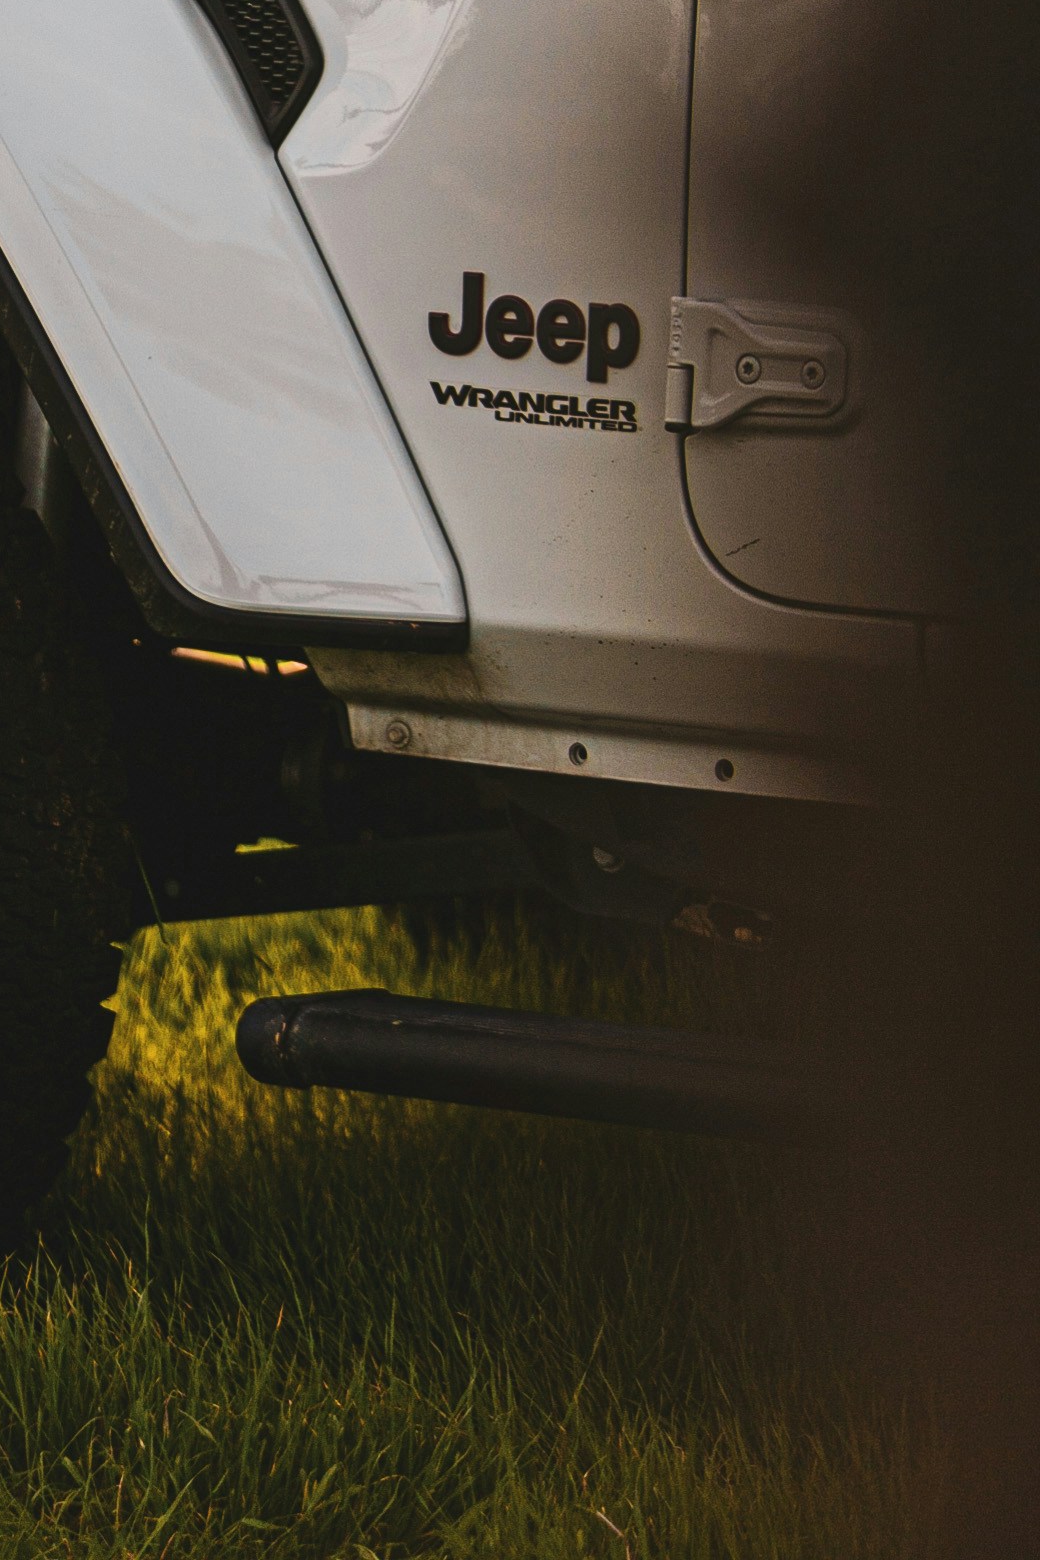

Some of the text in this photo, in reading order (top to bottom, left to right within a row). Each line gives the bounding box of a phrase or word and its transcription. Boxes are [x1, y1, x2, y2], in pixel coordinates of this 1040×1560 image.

[428, 271, 641, 384] Jeep
[429, 381, 637, 423] WRANGLER
[494, 410, 638, 433] UNLIMITED
